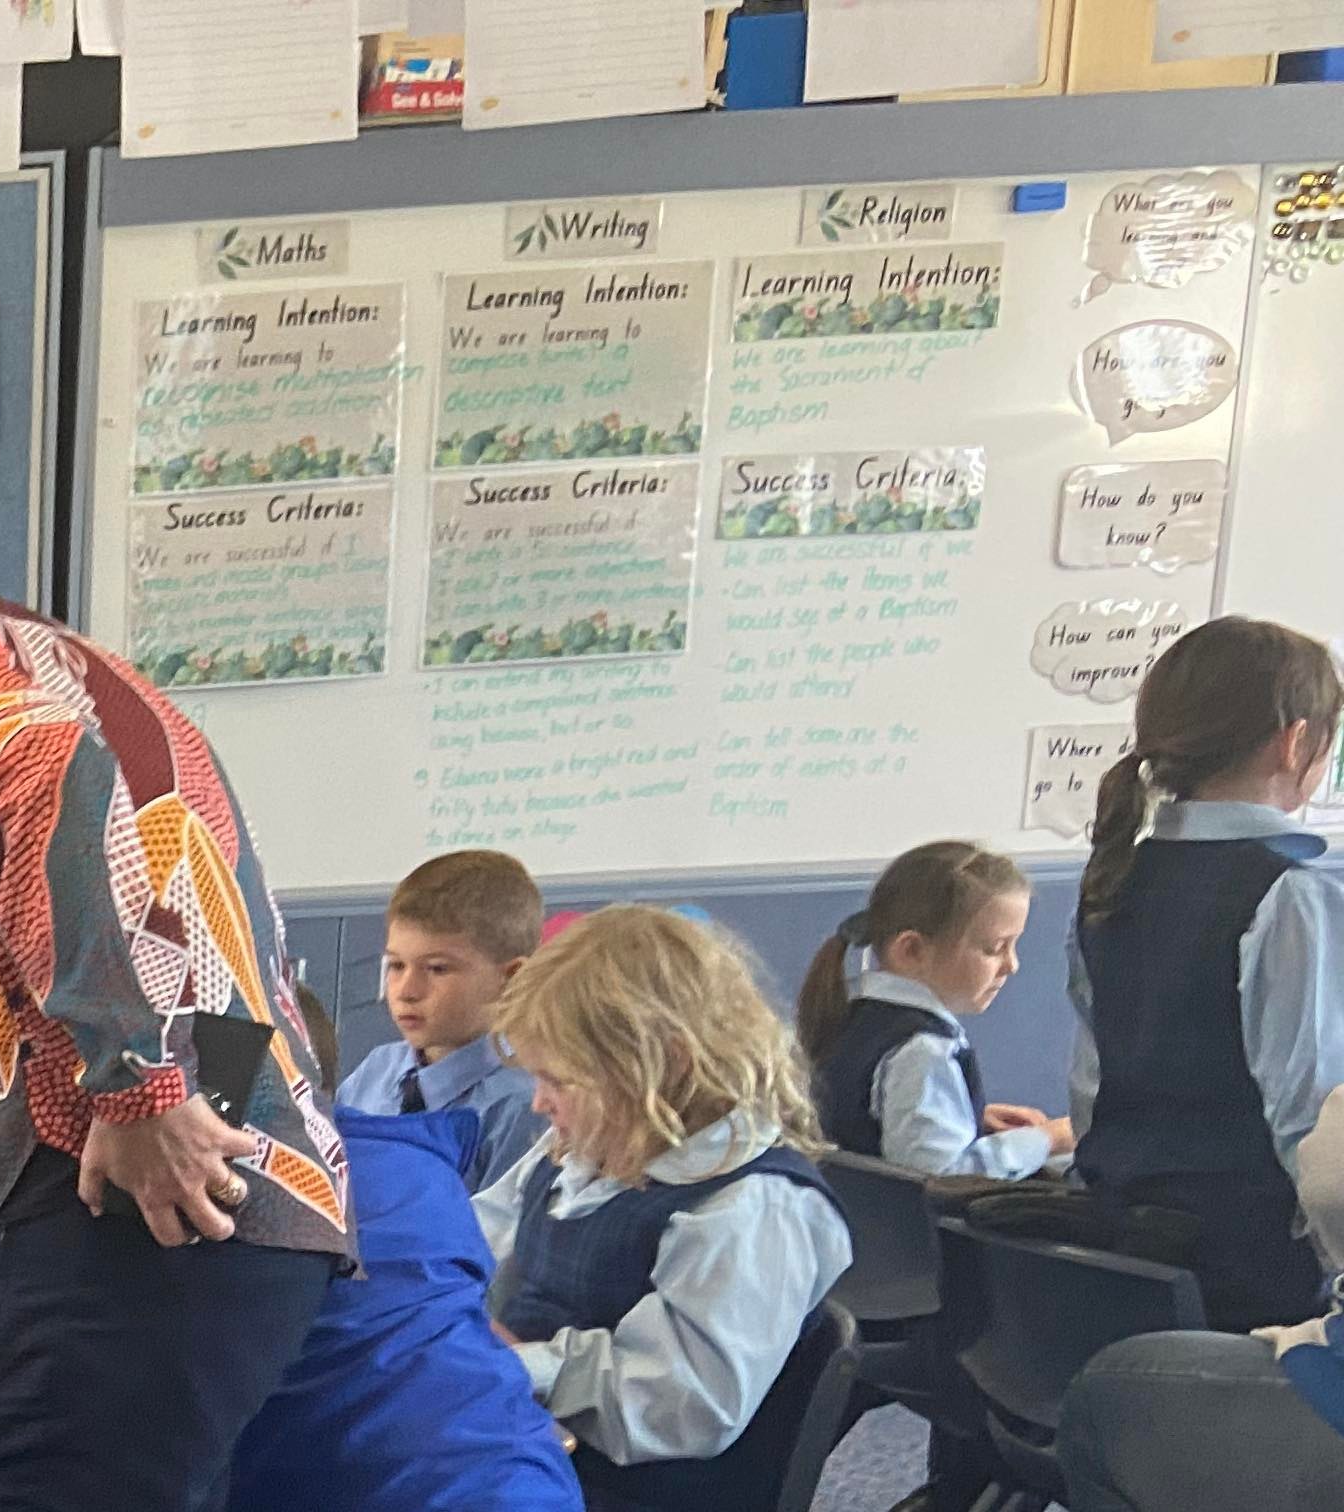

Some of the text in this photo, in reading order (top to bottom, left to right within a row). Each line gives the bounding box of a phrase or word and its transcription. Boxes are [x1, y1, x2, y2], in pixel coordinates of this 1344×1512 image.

[859, 195, 947, 236] Religion
[1205, 197, 1233, 217] you
[561, 210, 649, 249] Writing
[256, 232, 327, 265] Maths
[466, 271, 689, 319] Learning Intention:
[742, 251, 1001, 306] Learning Intention:
[161, 294, 379, 344] Learning Intention:
[449, 317, 642, 349] We are learning to
[193, 354, 221, 372] are
[237, 346, 302, 374] learning
[318, 341, 334, 363] to
[464, 468, 668, 506] Success Criteria:
[732, 460, 830, 495] Success
[164, 493, 364, 531] Success Criteria:
[1079, 481, 1205, 515] How do you
[1106, 521, 1168, 548] know?
[1049, 621, 1182, 648] How can you
[1070, 654, 1154, 691] improve?
[1047, 737, 1103, 757] Where
[1034, 771, 1083, 803] go to
